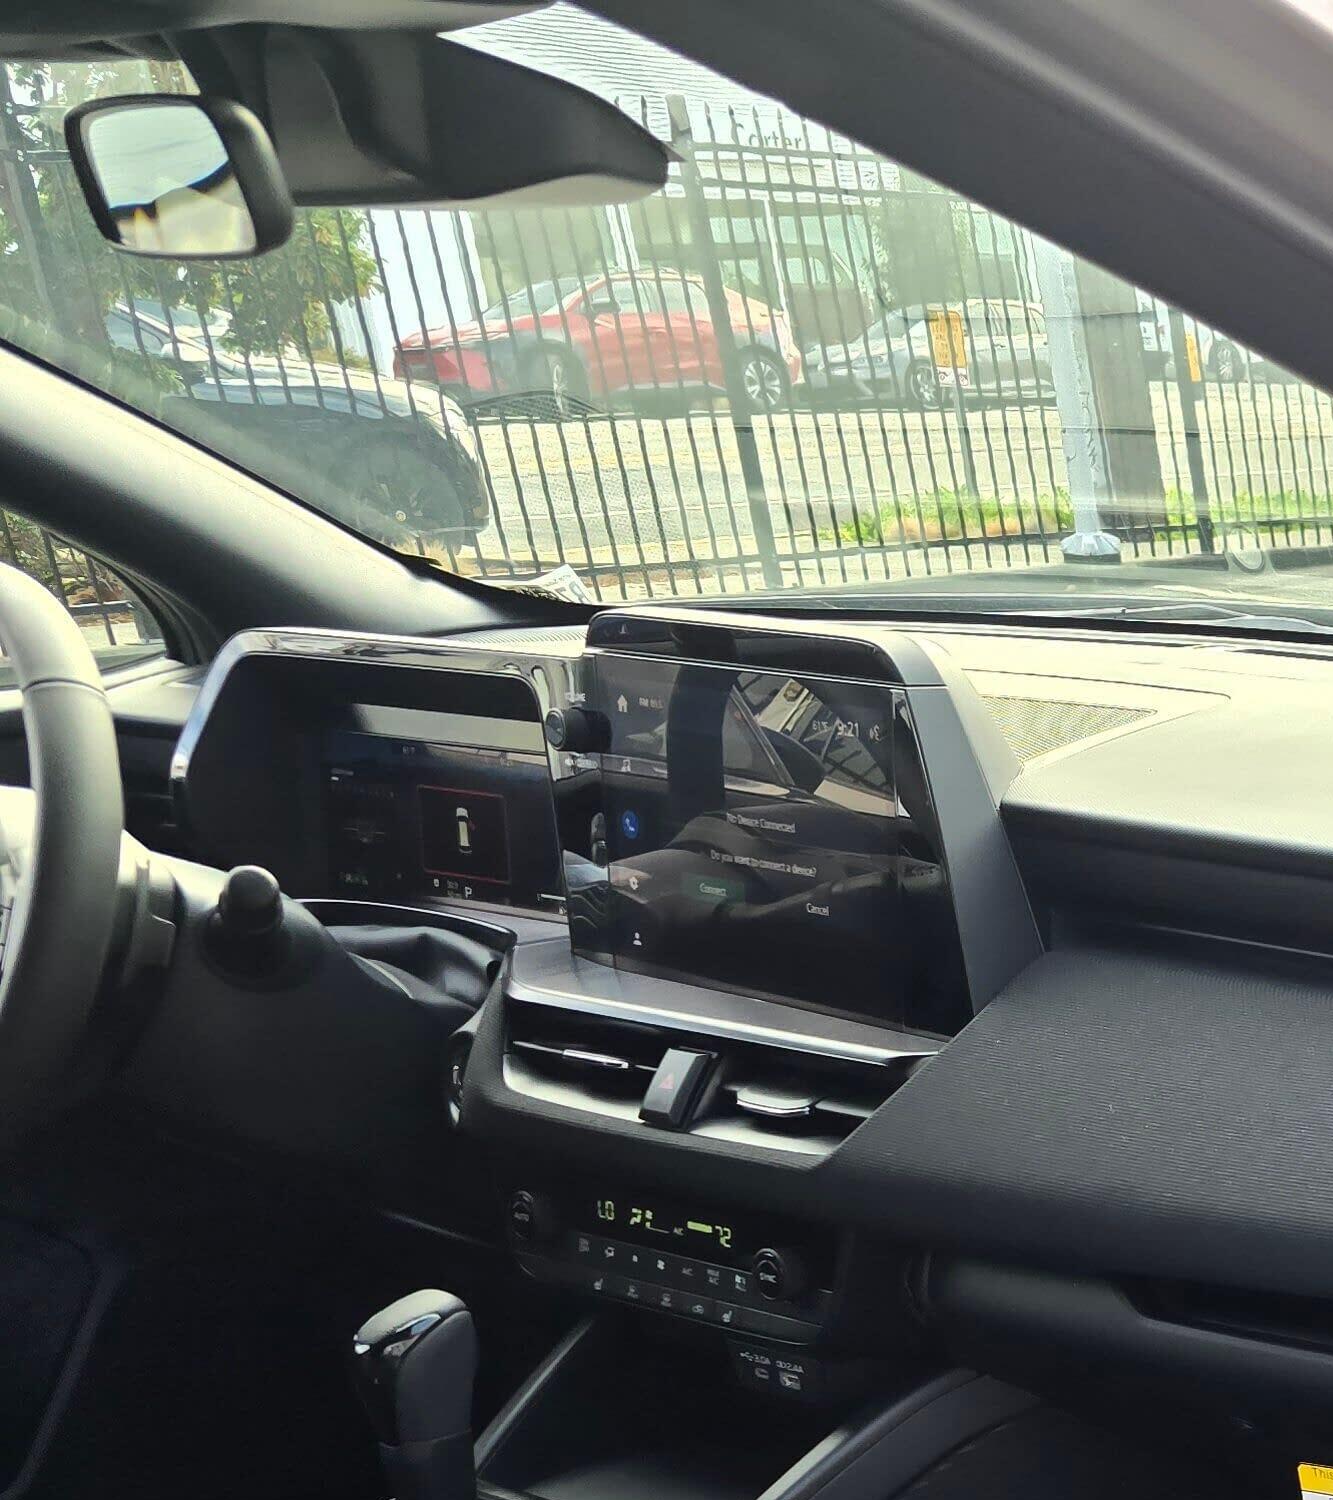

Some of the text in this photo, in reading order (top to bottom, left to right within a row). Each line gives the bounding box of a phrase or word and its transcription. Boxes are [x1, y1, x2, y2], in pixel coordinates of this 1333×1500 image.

[837, 719, 859, 738] 9:21
[806, 903, 830, 917] Cancel
[715, 1225, 732, 1248] 72
